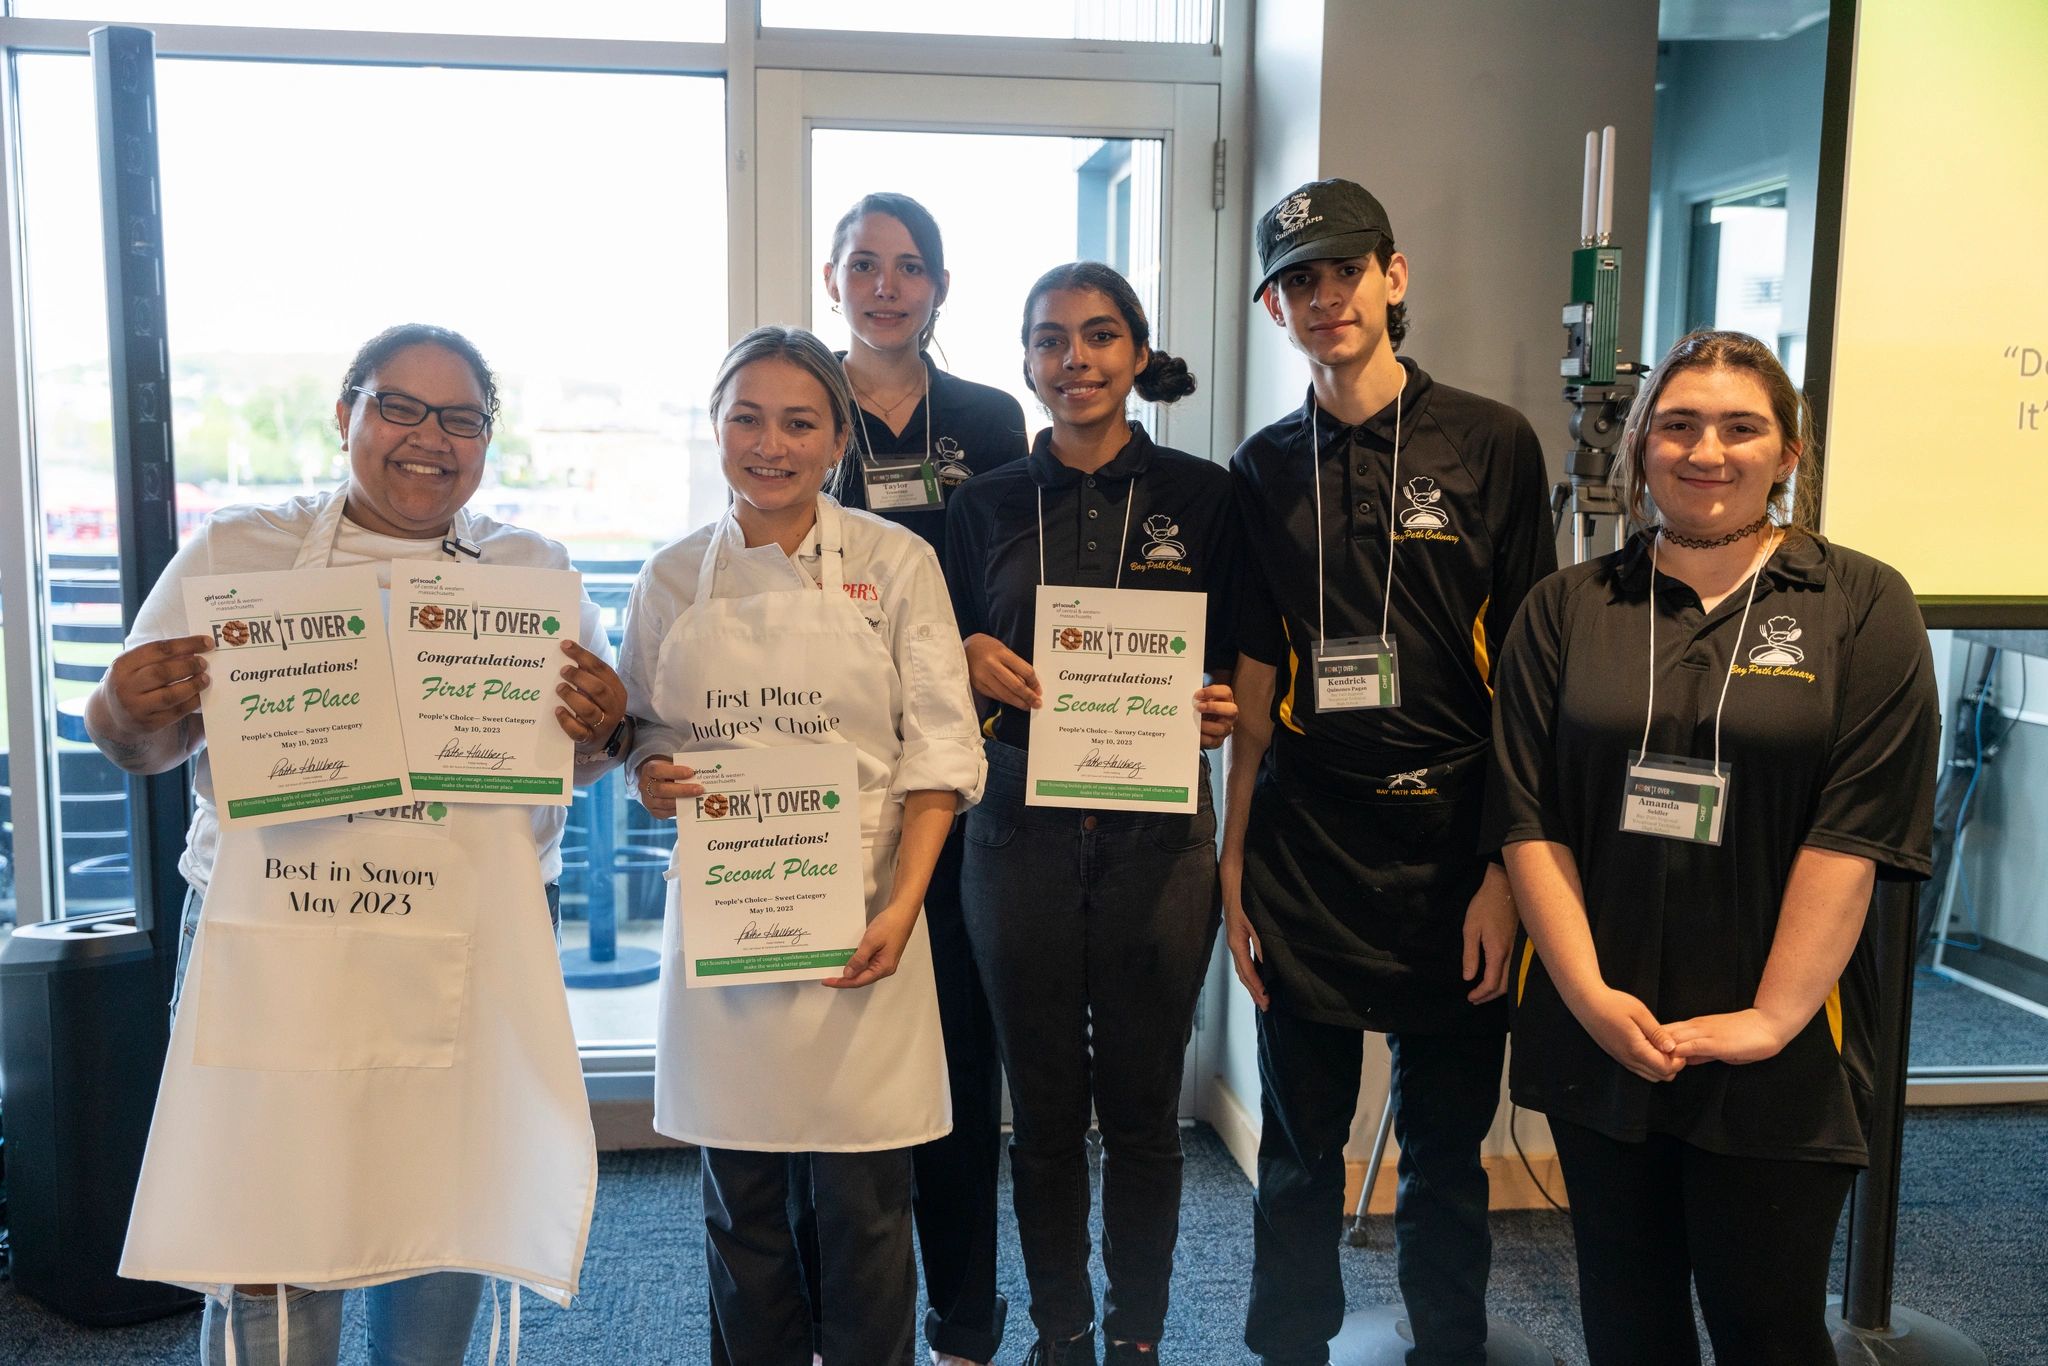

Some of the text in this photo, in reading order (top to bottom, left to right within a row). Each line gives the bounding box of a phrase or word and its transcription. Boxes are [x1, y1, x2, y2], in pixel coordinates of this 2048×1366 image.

[1276, 215, 1323, 240] Culinary Arts
[1404, 529, 1424, 539] Path
[1425, 529, 1460, 544] Culinary
[1130, 560, 1192, 576] Bay Path Culinary
[204, 594, 214, 602] girl
[300, 615, 346, 640] OVER
[496, 611, 540, 635] OVER
[1128, 632, 1168, 654] OVER
[230, 658, 358, 682] Congratulations!
[417, 651, 545, 669] Congratulations!
[1059, 670, 1173, 685] Congratulations!
[1328, 677, 1366, 686] Kendrick
[1730, 664, 1816, 683] Bay Path Culinary
[422, 676, 540, 701] First Place
[706, 686, 822, 709] First Place
[240, 688, 360, 721] First Place
[1054, 694, 1178, 716] Second Place
[332, 723, 362, 731] Category
[505, 717, 536, 725] Category
[691, 714, 840, 742] Judges' Choice
[778, 790, 821, 813] OVER
[1638, 798, 1679, 810] Amanda
[707, 832, 828, 852] Congratulations!
[265, 858, 438, 890] Best in Savory
[705, 858, 838, 885] Second Place
[288, 891, 411, 917] May 2023
